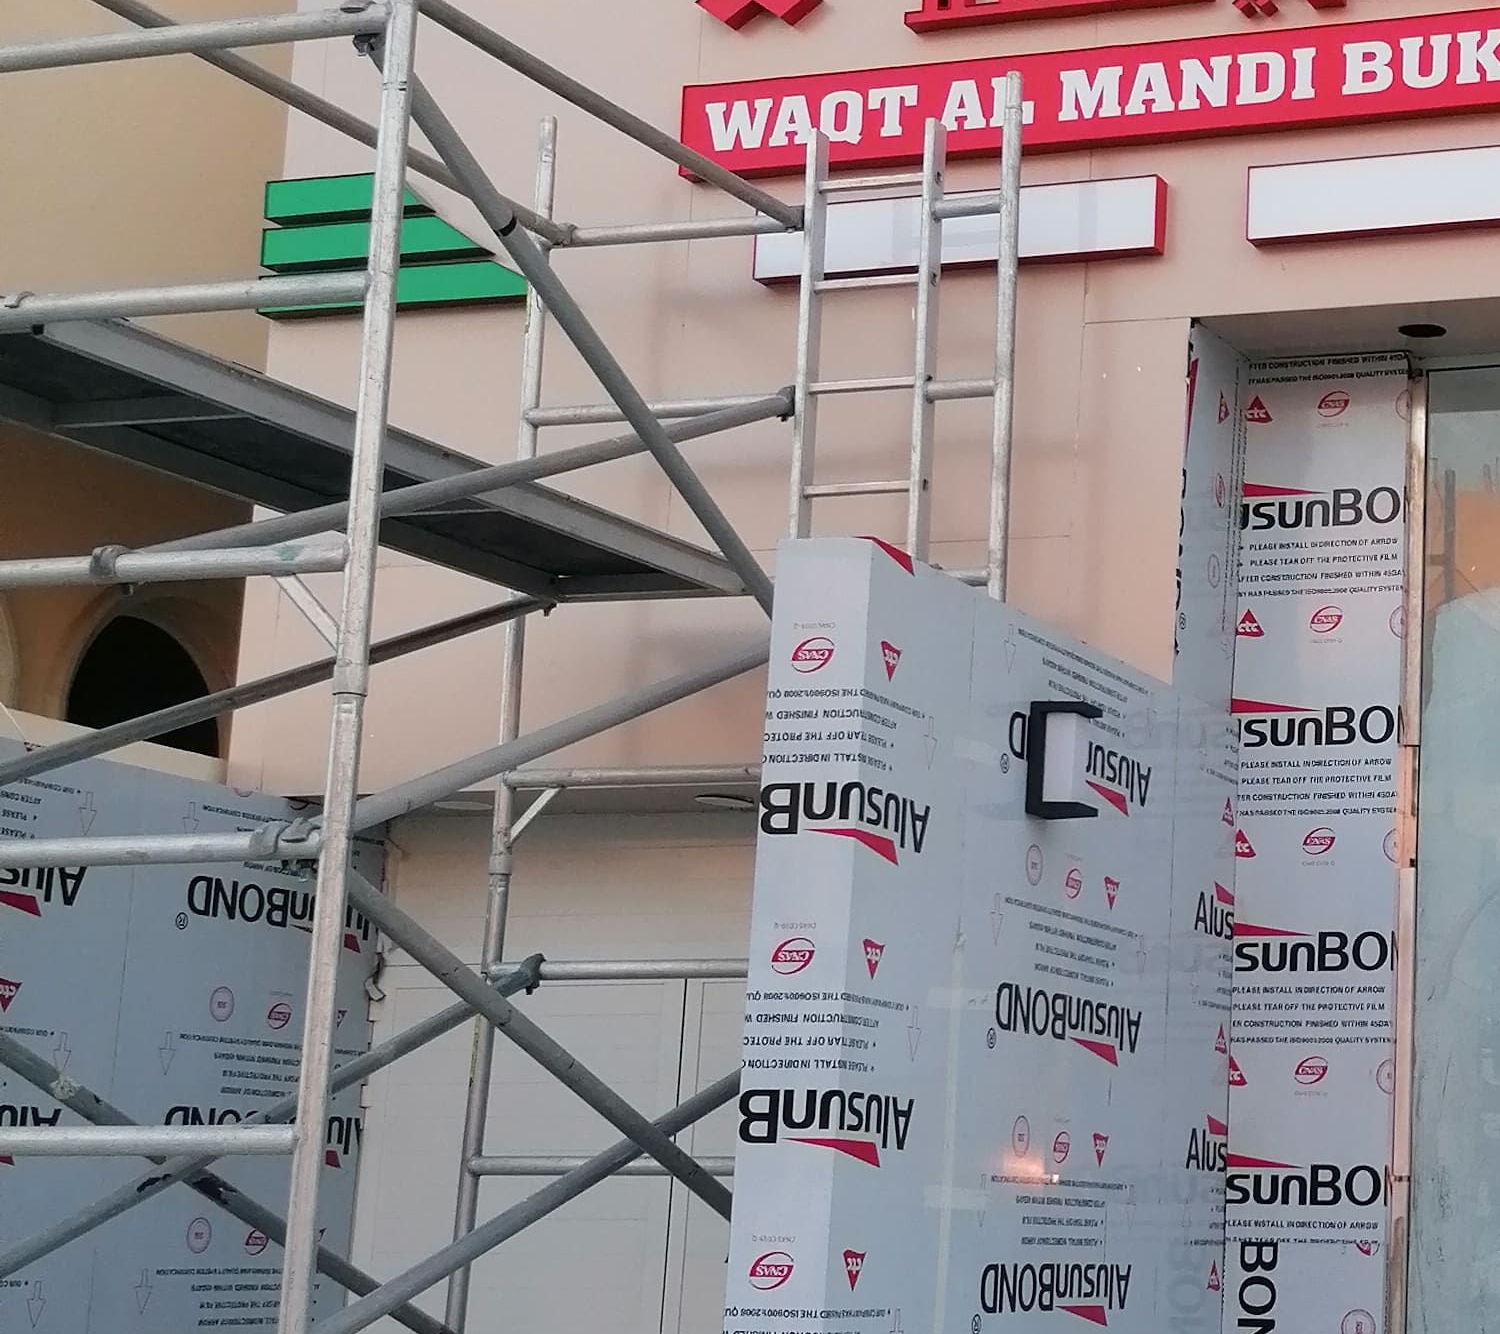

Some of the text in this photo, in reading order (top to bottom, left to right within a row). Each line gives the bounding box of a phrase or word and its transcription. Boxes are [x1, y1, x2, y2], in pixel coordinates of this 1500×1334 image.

[705, 84, 919, 152] WAQT
[1058, 46, 1316, 122] MANDI
[1240, 486, 1407, 531] sunBO
[760, 780, 931, 854] AlusunB
[1235, 931, 1398, 972] sunBO
[997, 981, 1142, 1054] AlusunBOND
[738, 1088, 915, 1151] AlusunB
[1226, 1164, 1388, 1207] sunBO
[981, 1263, 1131, 1314] AlusunBOND
